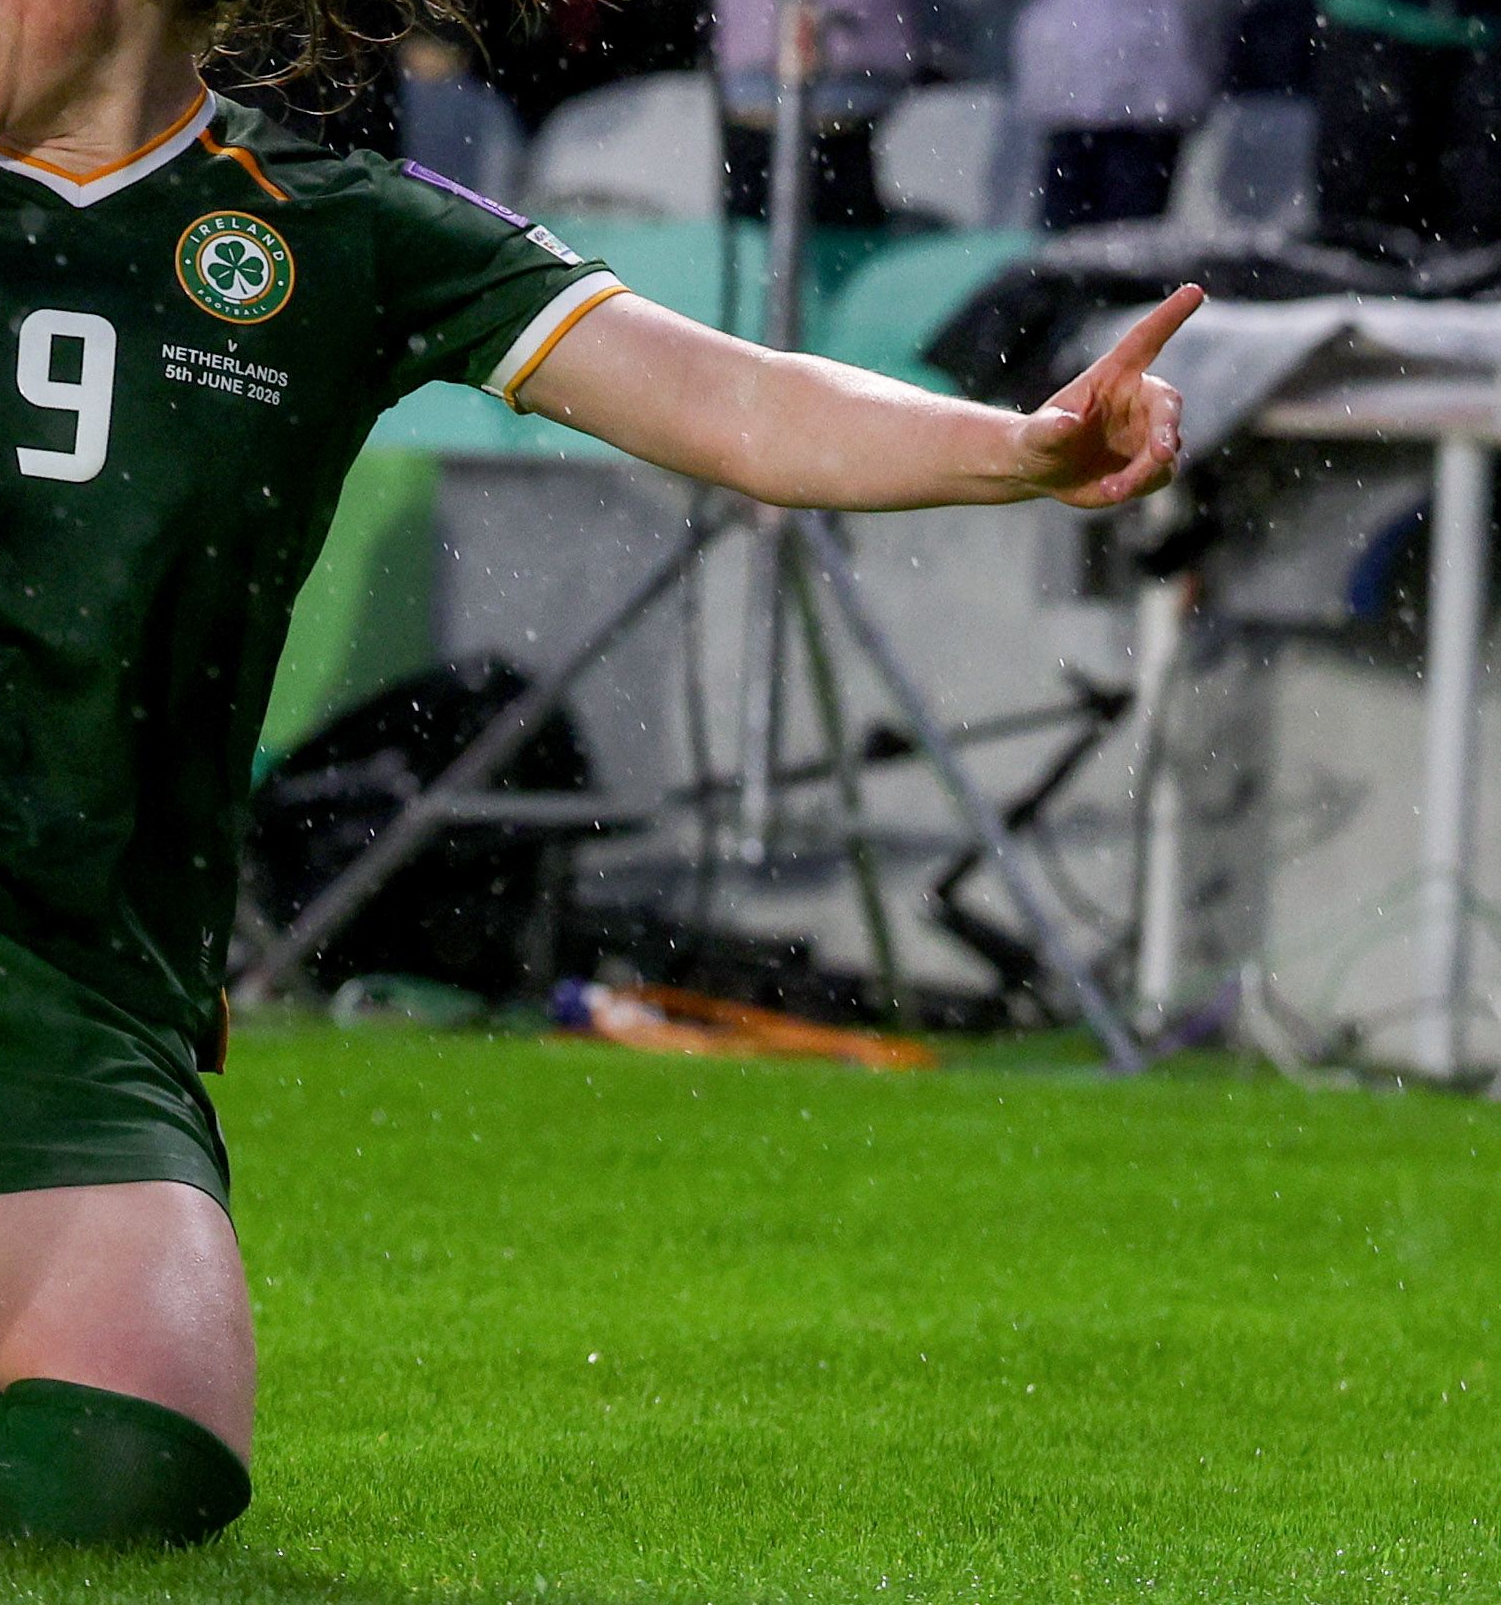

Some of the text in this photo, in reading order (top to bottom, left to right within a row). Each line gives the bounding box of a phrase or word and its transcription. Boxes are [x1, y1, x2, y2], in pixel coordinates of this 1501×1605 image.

[190, 217, 284, 261] IRELAND
[197, 289, 267, 316] FOOTBALL
[161, 343, 289, 388] NETHERLANDS
[164, 363, 281, 406] 5th JUNE 2026
[15, 308, 117, 483] 9
